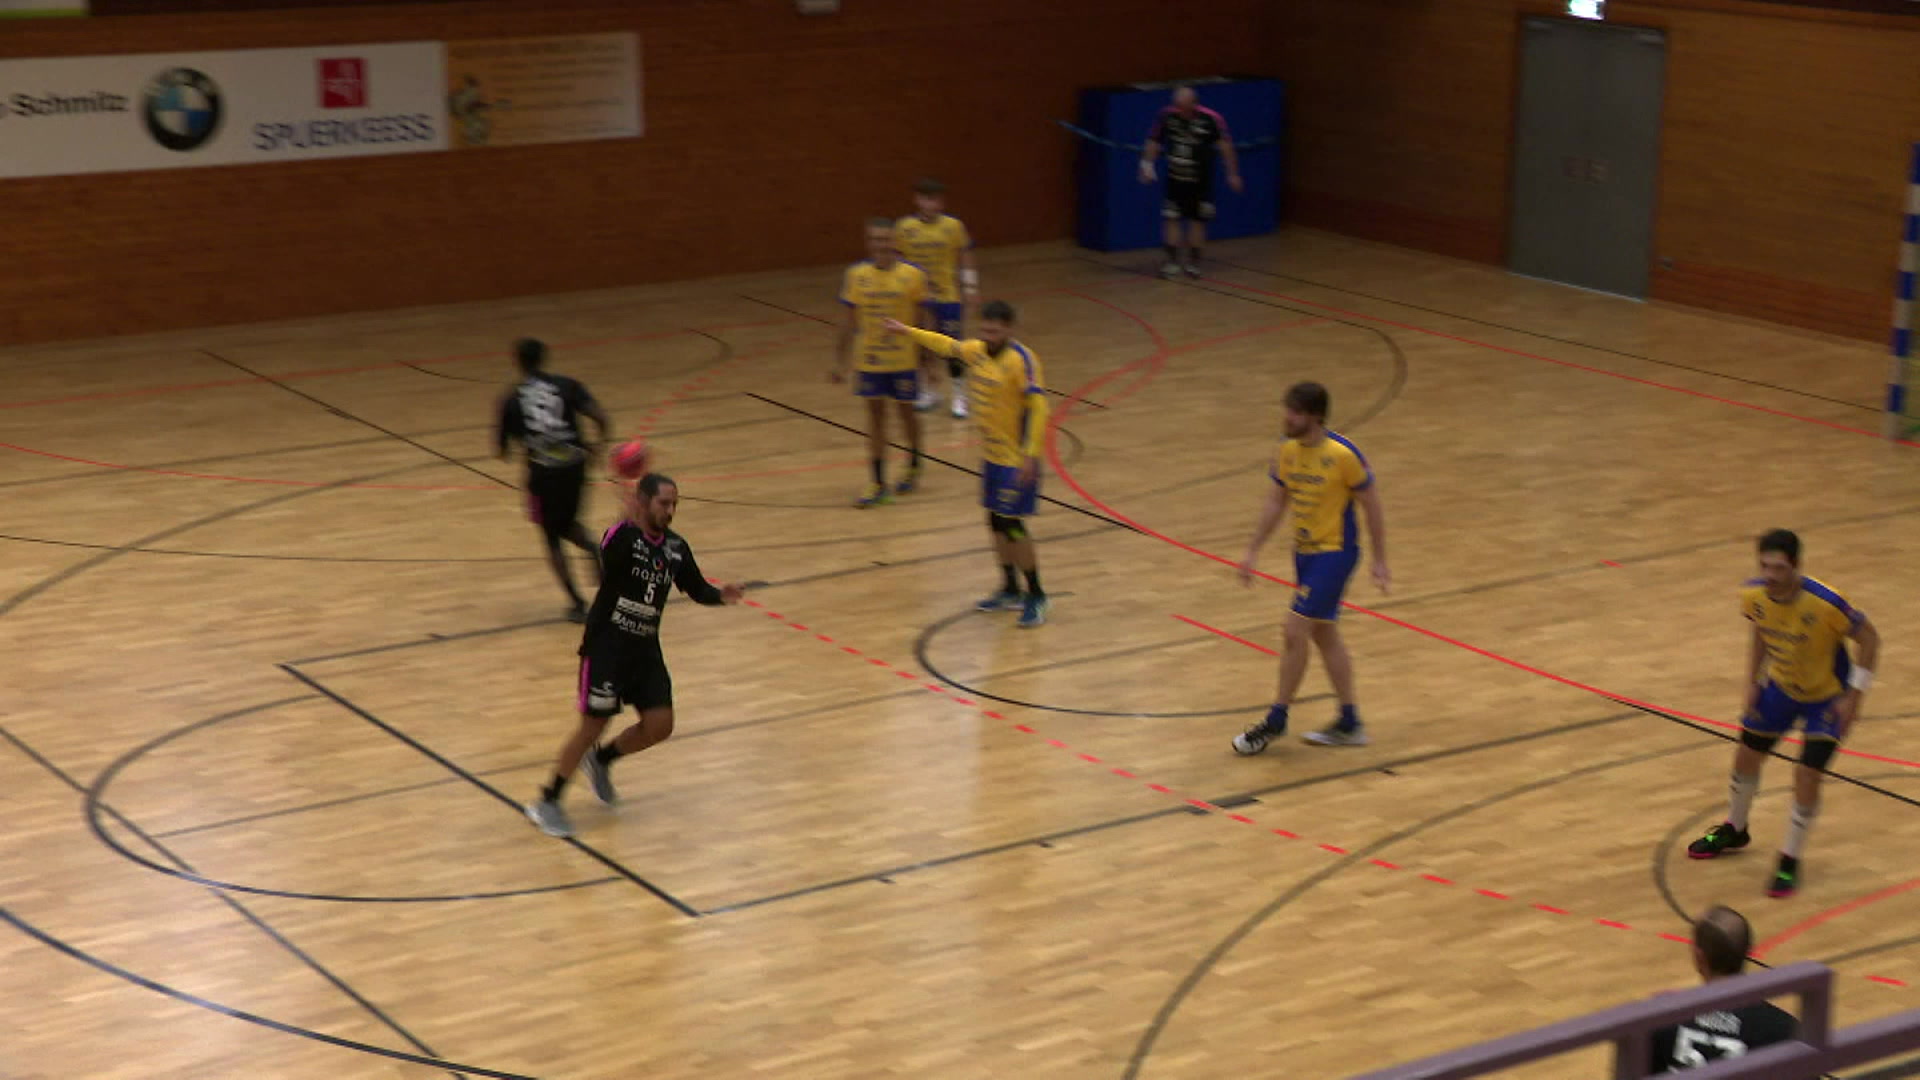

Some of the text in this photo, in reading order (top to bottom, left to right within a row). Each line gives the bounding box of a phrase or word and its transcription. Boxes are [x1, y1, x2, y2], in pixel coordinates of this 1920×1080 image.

[11, 91, 129, 117] Schmitz
[253, 113, 436, 151] SPUERKEESS
[643, 581, 657, 605] 5
